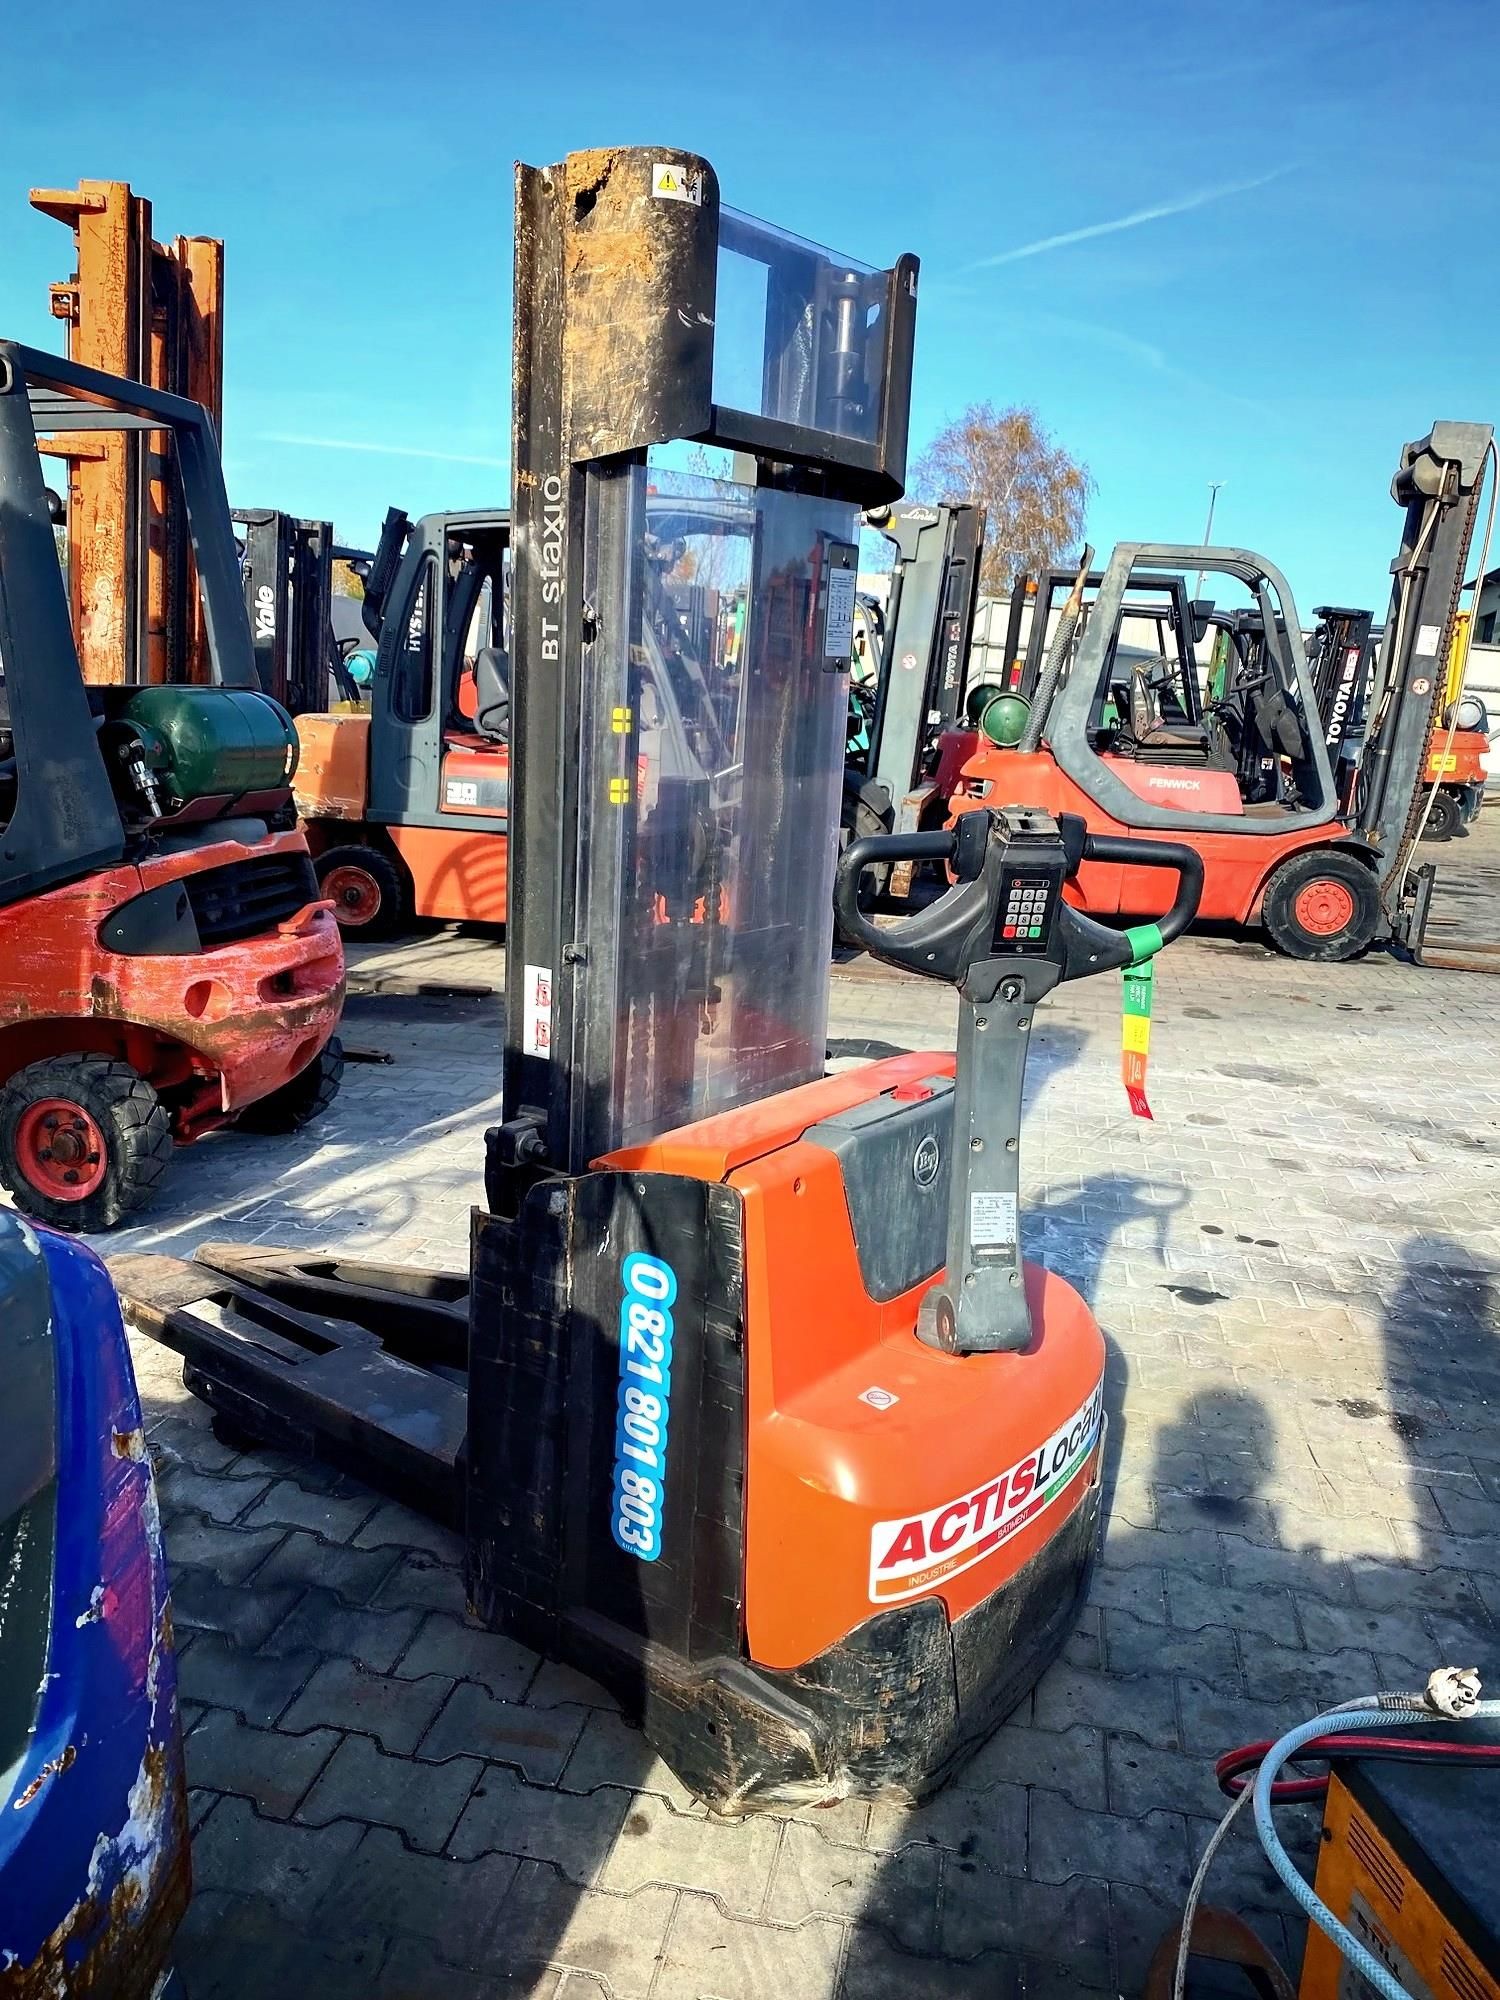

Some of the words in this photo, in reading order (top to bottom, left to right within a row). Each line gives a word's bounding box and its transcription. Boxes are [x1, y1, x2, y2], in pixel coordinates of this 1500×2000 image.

[900, 507, 937, 522] Linde
[254, 585, 276, 639] Yale
[408, 584, 424, 652] HYSTE
[541, 617, 559, 661] BT
[944, 644, 958, 690] TOYOTA
[1326, 681, 1353, 746] TOYOTA
[1149, 777, 1201, 791] FENWICK
[630, 1262, 670, 1300] 0
[627, 1301, 666, 1385] 821
[623, 1386, 662, 1469] 801
[618, 1468, 657, 1553] 803
[907, 1558, 958, 1588] INDUSTRIE
